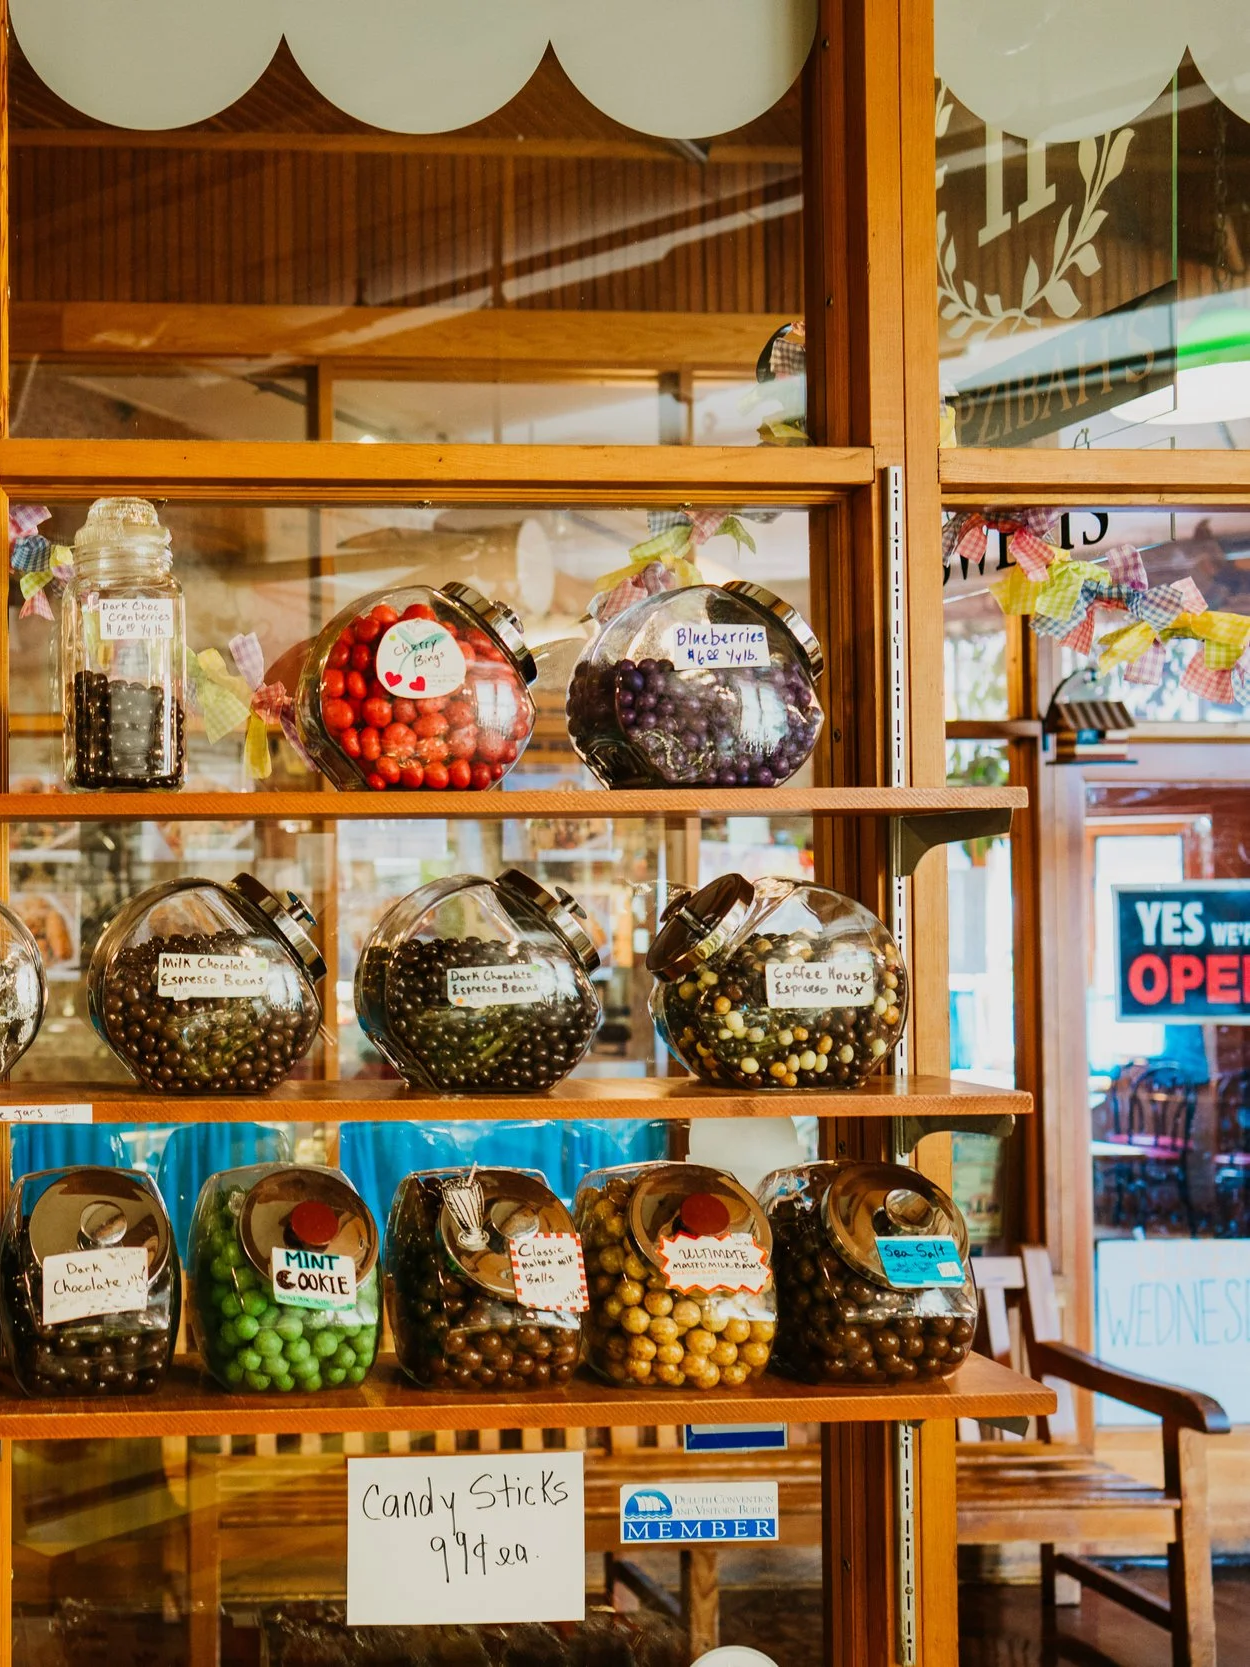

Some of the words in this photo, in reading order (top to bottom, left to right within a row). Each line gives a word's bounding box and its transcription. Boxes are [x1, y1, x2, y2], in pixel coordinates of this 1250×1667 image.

[103, 602, 127, 611] Dark
[109, 613, 170, 622] Cranberries
[676, 627, 765, 646] Blueberries
[393, 639, 438, 656] Cherry
[413, 651, 445, 668] Bings
[1135, 901, 1206, 946] YES
[162, 957, 191, 969] Milk
[197, 958, 251, 970] Chocolate
[160, 973, 217, 987] Espresso
[224, 974, 264, 986] Beans
[450, 970, 479, 982] Dark
[483, 970, 533, 981] Chocolate
[773, 965, 823, 979] Coffee
[828, 966, 872, 983] House
[1128, 953, 1250, 1005] OPE
[452, 984, 498, 995] Espresso
[501, 983, 539, 994] Beans
[775, 981, 829, 998] Espresso
[836, 984, 863, 997] Mix
[518, 1243, 565, 1257] Classic
[678, 1248, 749, 1262] ULTIMATE
[884, 1244, 913, 1258] Sea
[915, 1242, 946, 1259] Salt
[66, 1262, 103, 1275] Dark
[285, 1250, 340, 1271] MINT
[521, 1259, 552, 1270] Malted
[557, 1254, 574, 1266] Milk
[53, 1276, 123, 1295] Chocolate
[276, 1269, 350, 1295] COOKIE
[525, 1272, 555, 1285] Balls
[1104, 1277, 1250, 1347] WEDNES
[362, 1476, 457, 1536] Candy
[469, 1470, 569, 1510] Sticks
[626, 1519, 774, 1539] MEMBER
[430, 1531, 488, 1584] 99¢
[495, 1543, 541, 1566] ea.
